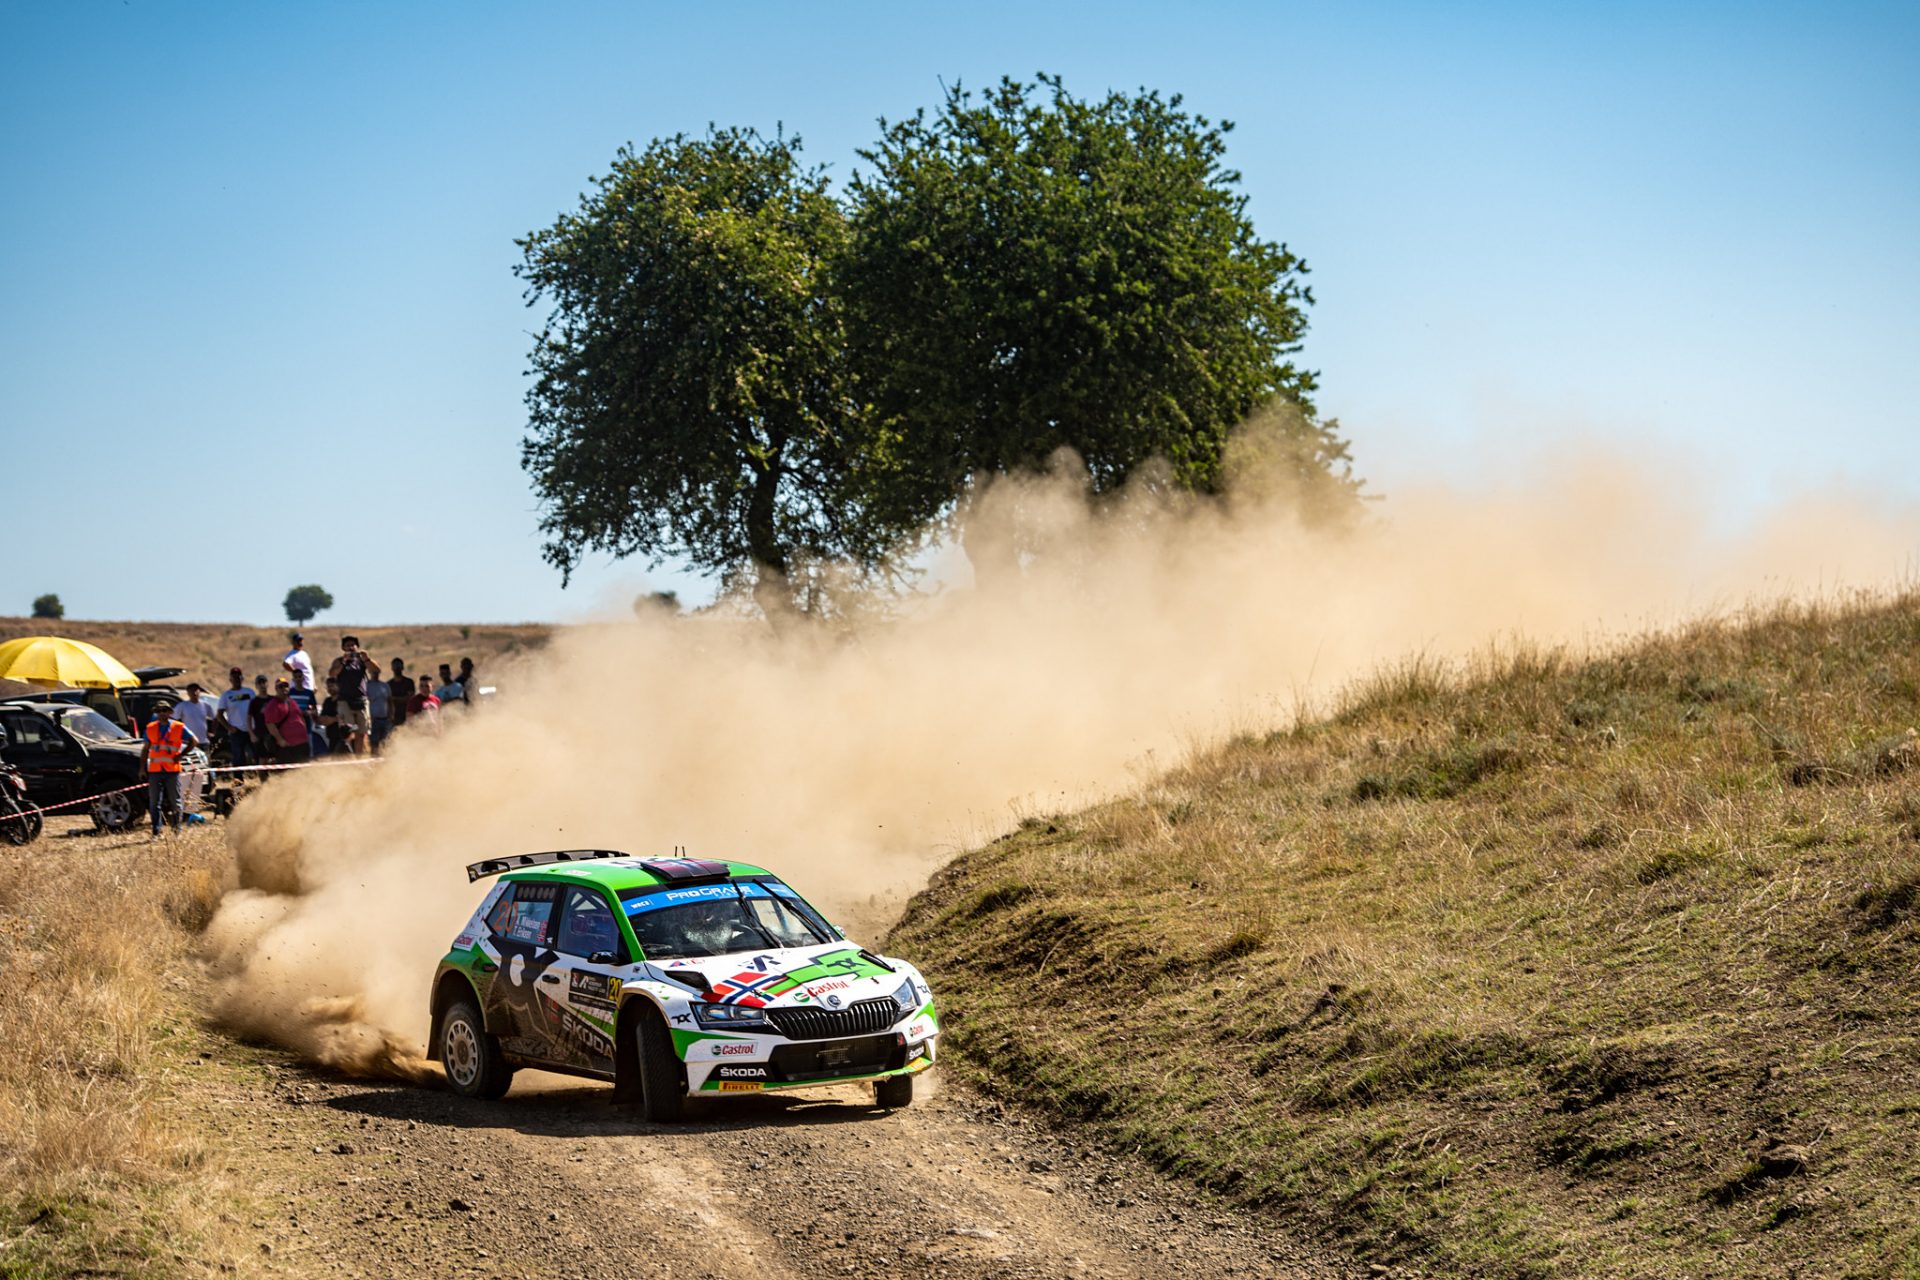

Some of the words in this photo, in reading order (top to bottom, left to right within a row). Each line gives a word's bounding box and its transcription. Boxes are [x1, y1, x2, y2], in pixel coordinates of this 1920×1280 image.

[493, 900, 519, 933] 20
[807, 980, 850, 997] Castrol
[722, 1043, 754, 1056] Castrol
[720, 1066, 767, 1078] ŠKODA
